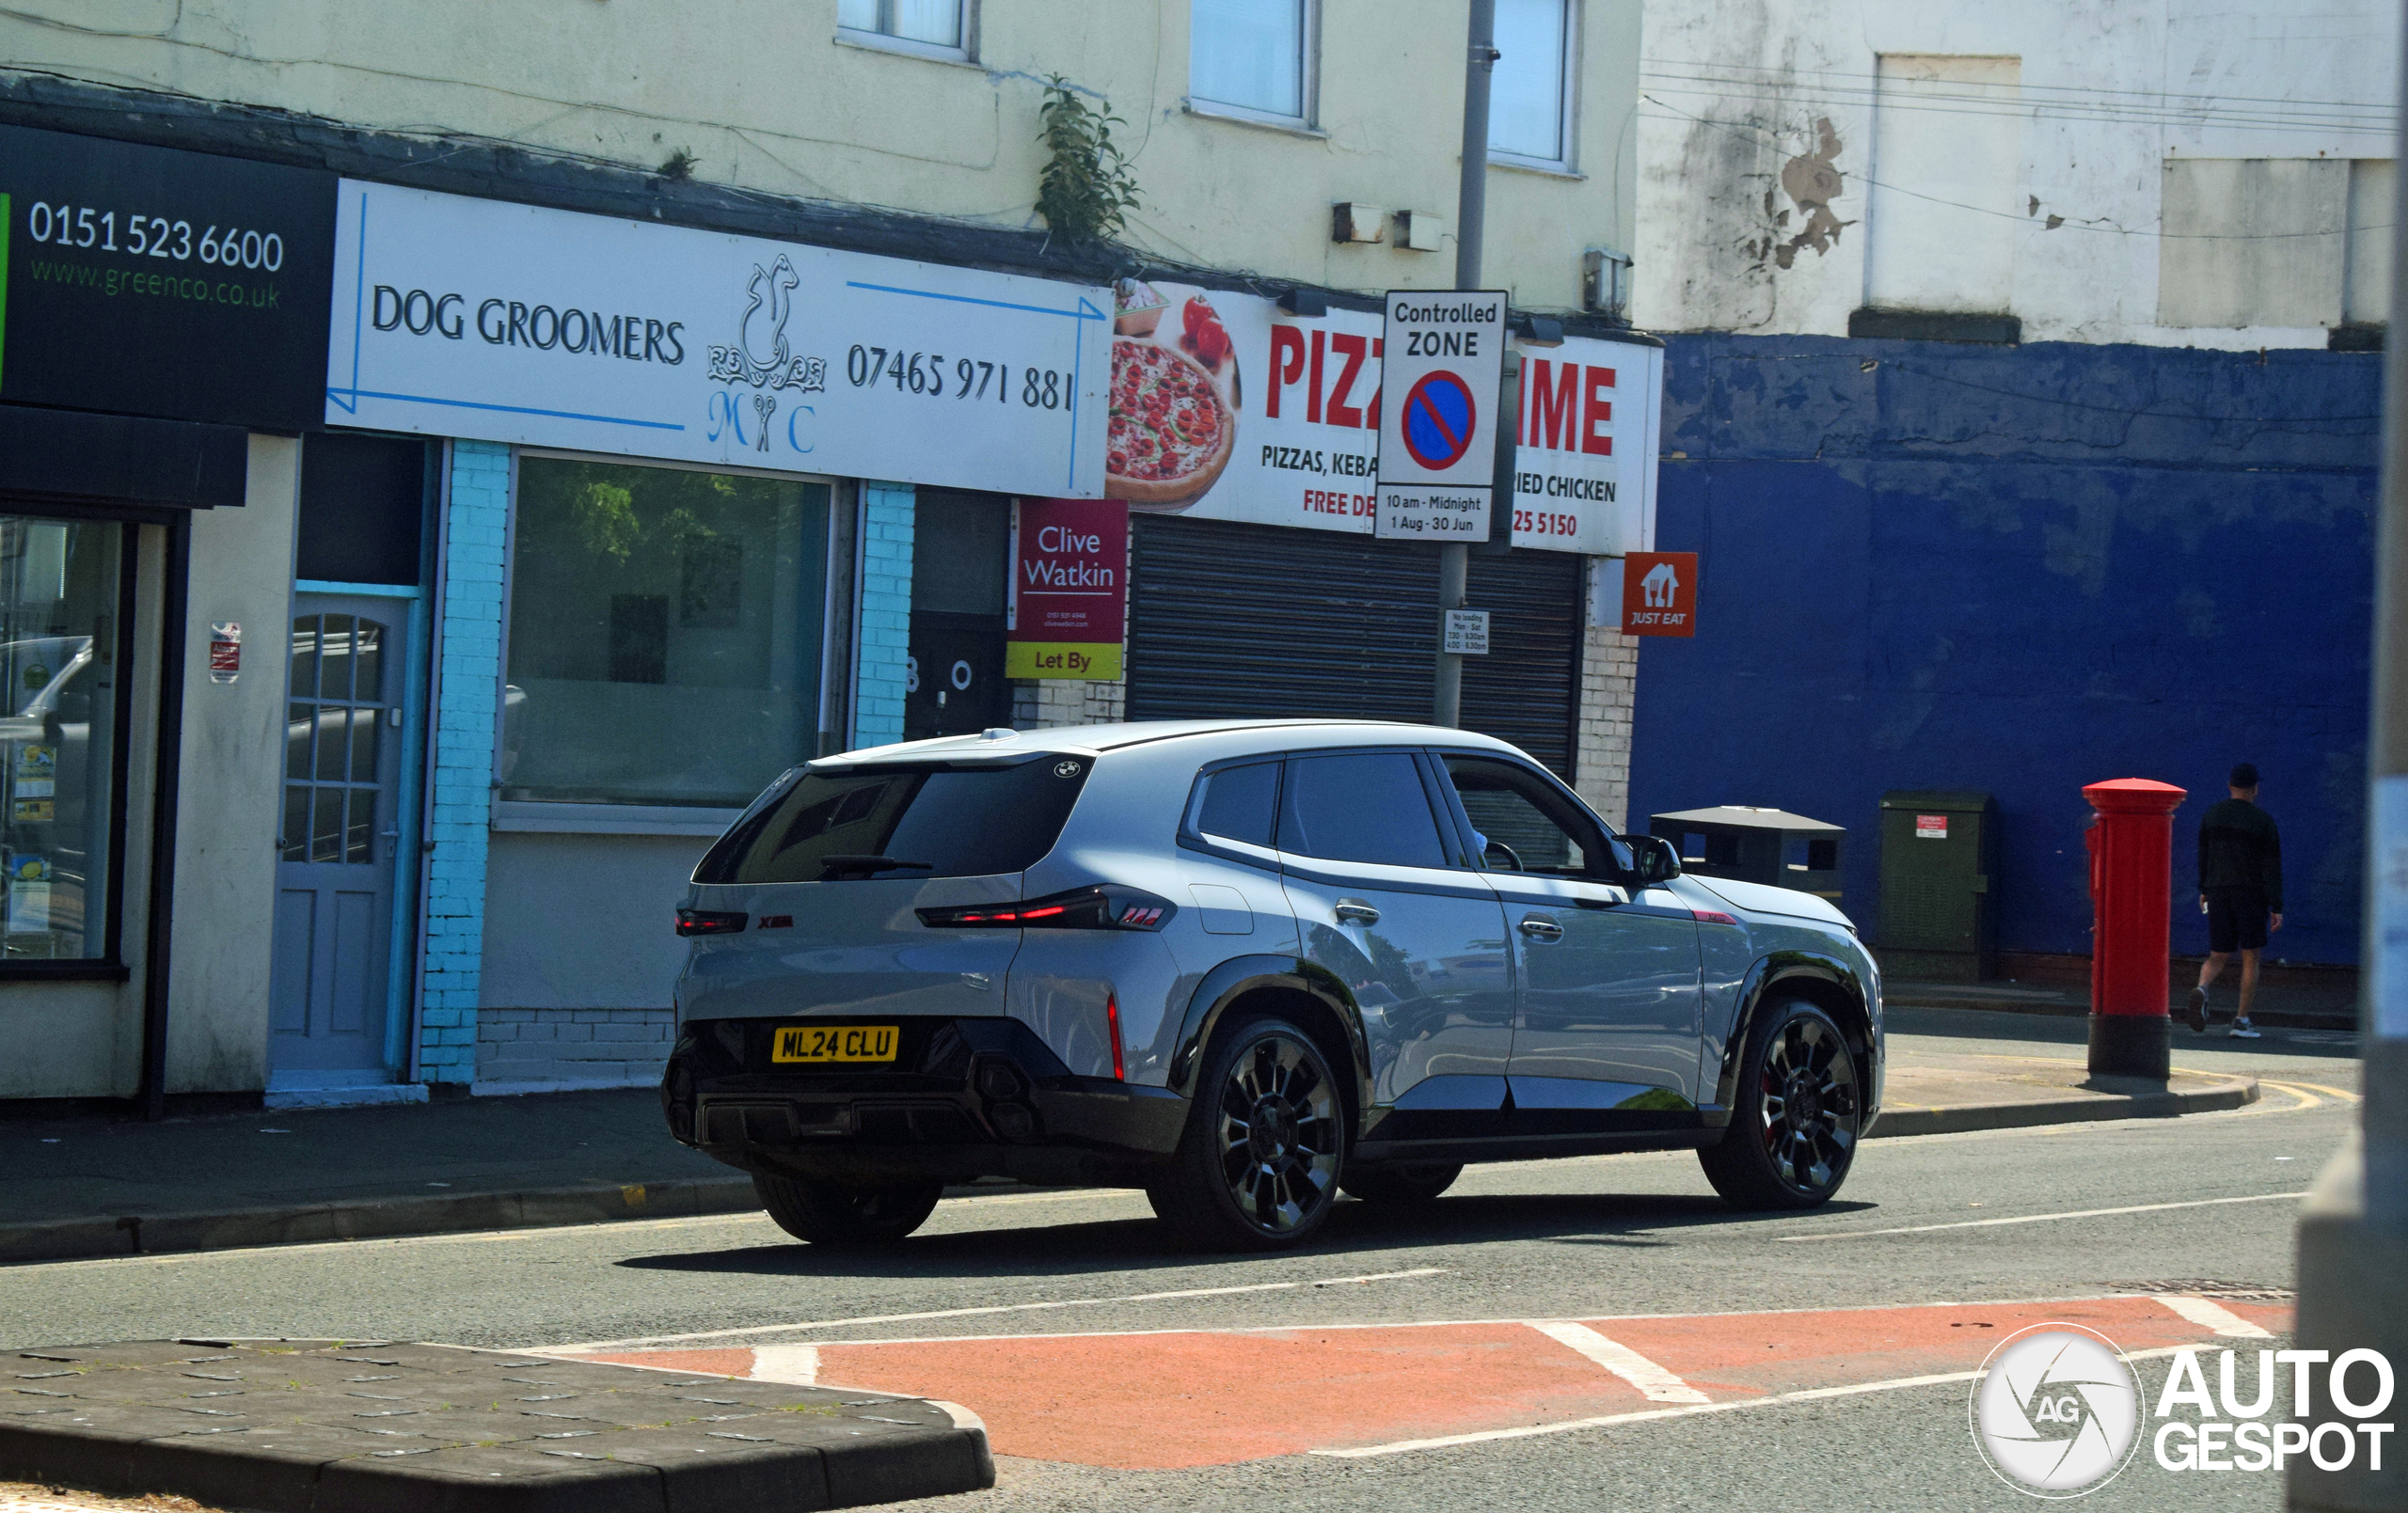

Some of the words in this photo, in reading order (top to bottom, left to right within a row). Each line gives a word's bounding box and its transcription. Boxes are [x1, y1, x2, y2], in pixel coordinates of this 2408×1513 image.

[29, 200, 119, 252] 0151
[126, 214, 192, 260] 523
[198, 224, 284, 273] 6600
[30, 259, 280, 308] www.greenco.co.uk
[372, 284, 465, 340] DOG
[476, 297, 686, 367] GROOMERS
[1394, 302, 1497, 323] Controlled
[1406, 331, 1479, 357] ZONE
[848, 343, 945, 397] 07465
[956, 357, 1007, 404] 971
[1022, 366, 1073, 412] 881
[1261, 444, 1328, 477] PIZZAS,
[1545, 474, 1616, 503] CHICKEN
[1303, 488, 1348, 515] FREE
[1352, 494, 1376, 518] DE
[1513, 509, 1533, 532] 25
[1536, 512, 1577, 537] 5150
[1386, 495, 1401, 509] 10
[1402, 497, 1419, 509] am
[1429, 496, 1481, 512] Midnight
[1392, 515, 1397, 528] 1
[1400, 515, 1423, 531] Aug
[1432, 517, 1450, 530] 30
[1452, 517, 1474, 531] Jun
[1038, 526, 1101, 553] Clive
[1023, 559, 1114, 587] Watkin
[1630, 611, 1661, 625] JUST
[1662, 612, 1687, 625] EAT
[1035, 651, 1065, 670] Let
[1068, 652, 1092, 674] By
[782, 1031, 839, 1057] ML24
[845, 1030, 892, 1057] CLU
